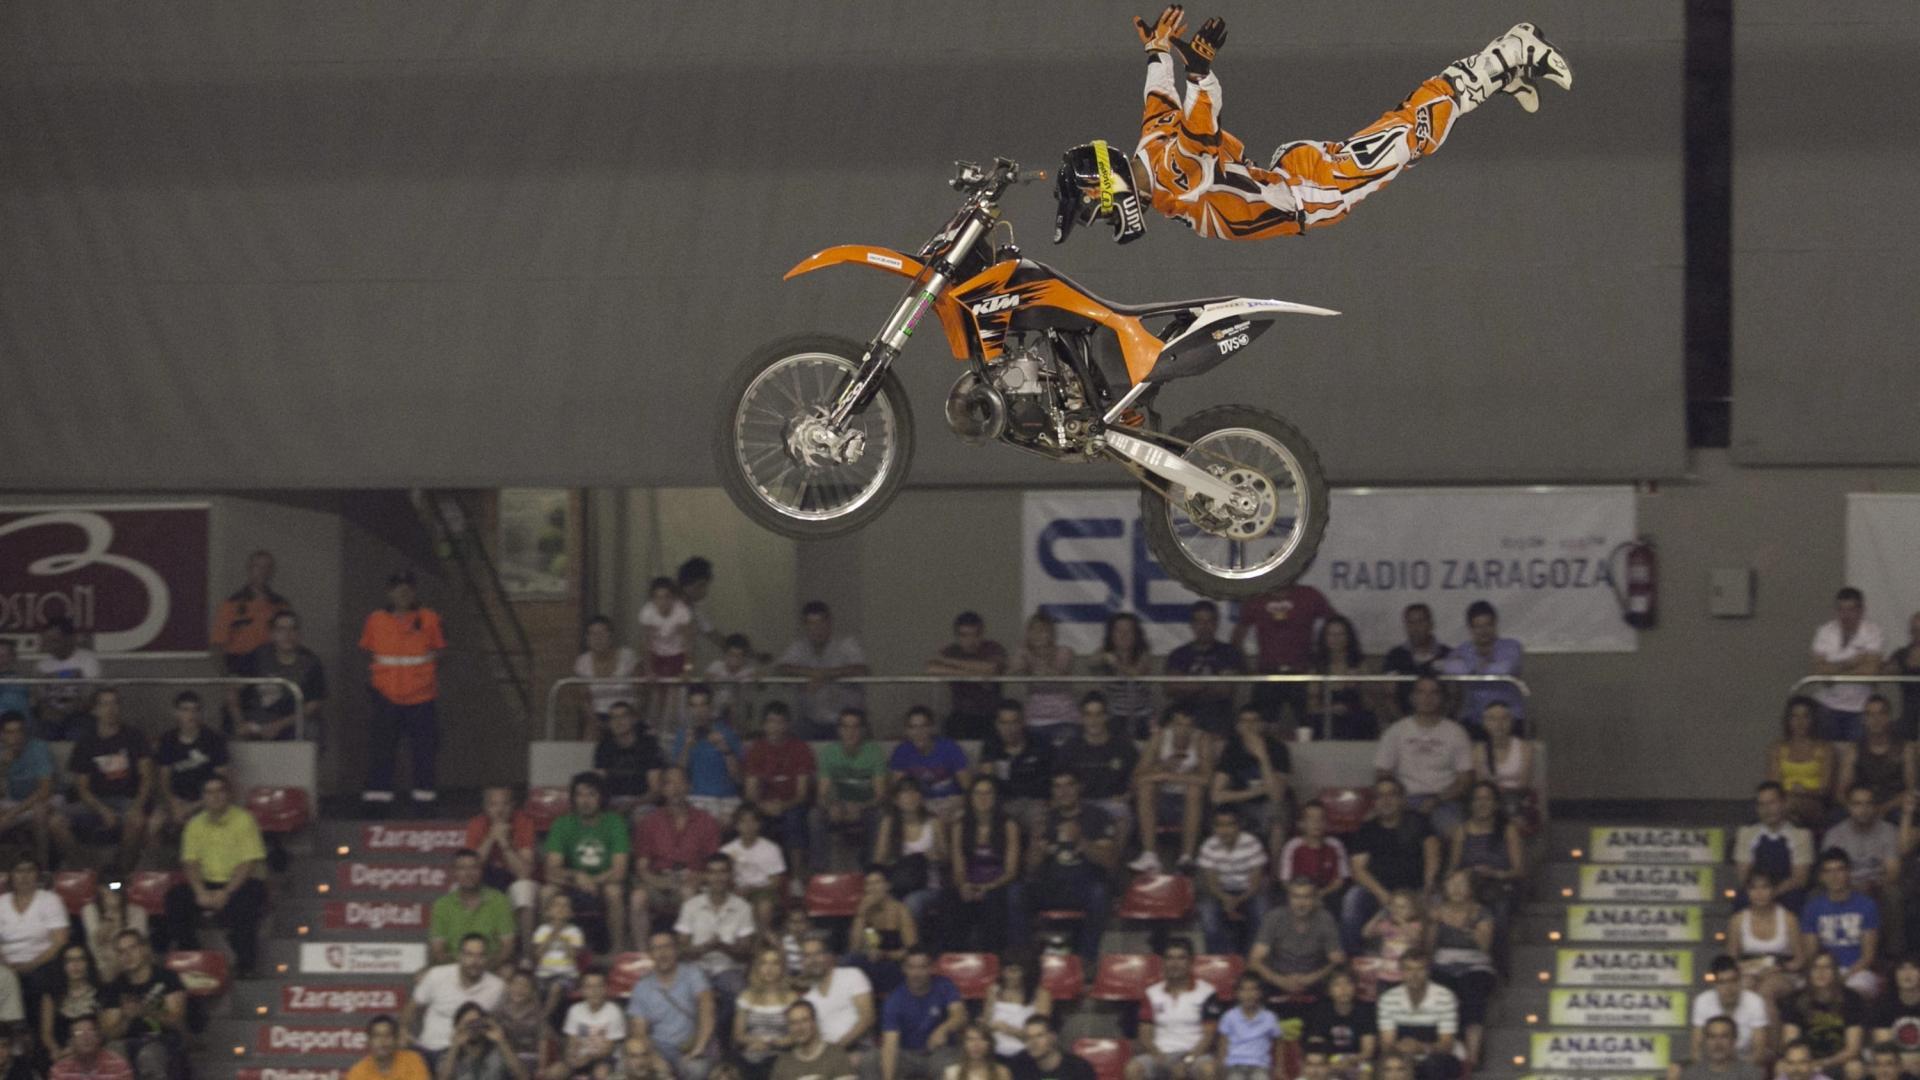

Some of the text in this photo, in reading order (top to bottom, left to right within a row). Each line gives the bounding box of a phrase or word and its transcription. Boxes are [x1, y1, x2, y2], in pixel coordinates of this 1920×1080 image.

[972, 294, 1020, 316] KTM
[1217, 337, 1240, 355] DVS
[1330, 558, 1614, 591] RADIO ZARAGOZA
[1607, 830, 1710, 848] ANAGAN
[351, 864, 446, 889] Deporte
[1596, 868, 1699, 885] ANAGAN
[345, 902, 422, 929] Digital
[1584, 909, 1689, 926] ANAGAN
[1573, 953, 1679, 969] ANAGAN
[289, 986, 397, 1012] Zaragoza
[1566, 993, 1671, 1010] ANAGAN
[270, 1026, 368, 1052] Deporte
[1549, 1036, 1655, 1053] ANAGAN
